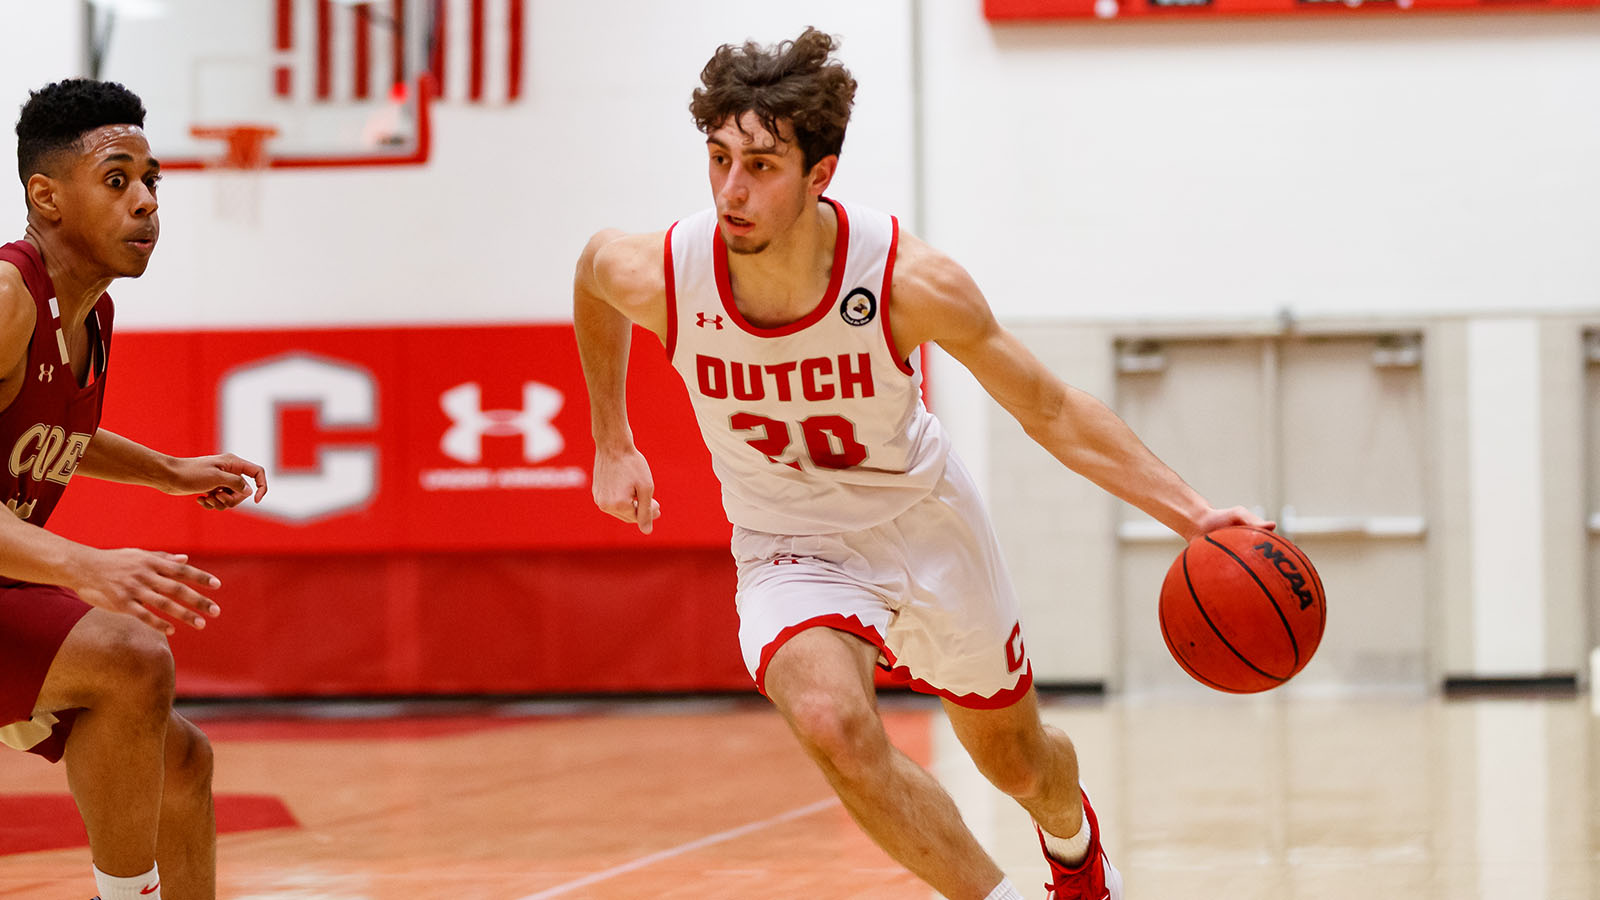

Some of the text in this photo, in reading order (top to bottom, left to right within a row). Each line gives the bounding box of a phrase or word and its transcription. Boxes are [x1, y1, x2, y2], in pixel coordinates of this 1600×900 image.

[696, 352, 875, 402] DUTCH
[8, 422, 93, 486] COE
[219, 351, 379, 525] C
[728, 411, 870, 472] 20
[1254, 541, 1314, 611] NCAA
[1005, 619, 1025, 675] C
